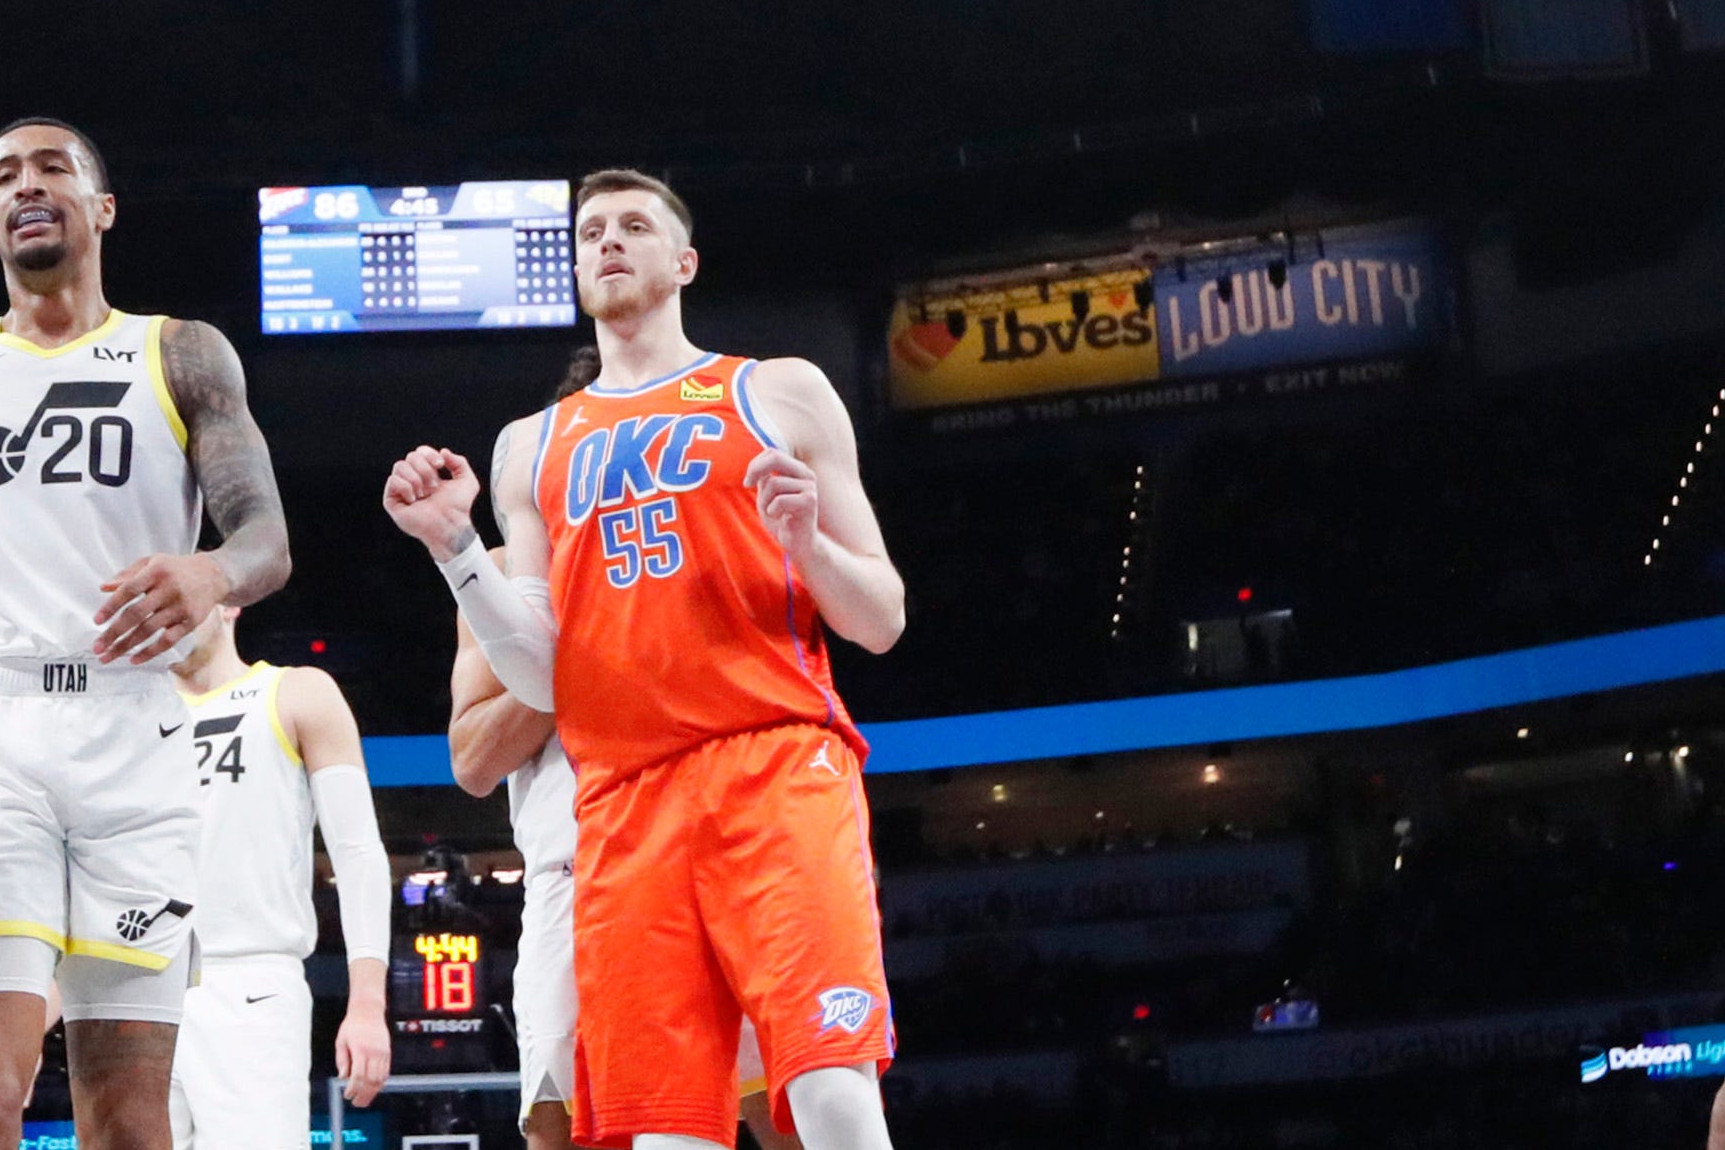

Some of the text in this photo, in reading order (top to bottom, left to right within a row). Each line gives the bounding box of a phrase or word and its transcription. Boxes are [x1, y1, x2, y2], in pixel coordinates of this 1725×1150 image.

[314, 191, 360, 220] 86
[1169, 259, 1422, 362] LOUD CITY
[93, 346, 138, 363] LVT
[40, 415, 133, 488] 20
[565, 413, 726, 526] OKC
[598, 498, 684, 590] 55
[43, 663, 88, 693] UTAH
[424, 961, 474, 1011] 18
[420, 1018, 483, 1033] TISSOT
[1609, 1043, 1693, 1071] Dobson
